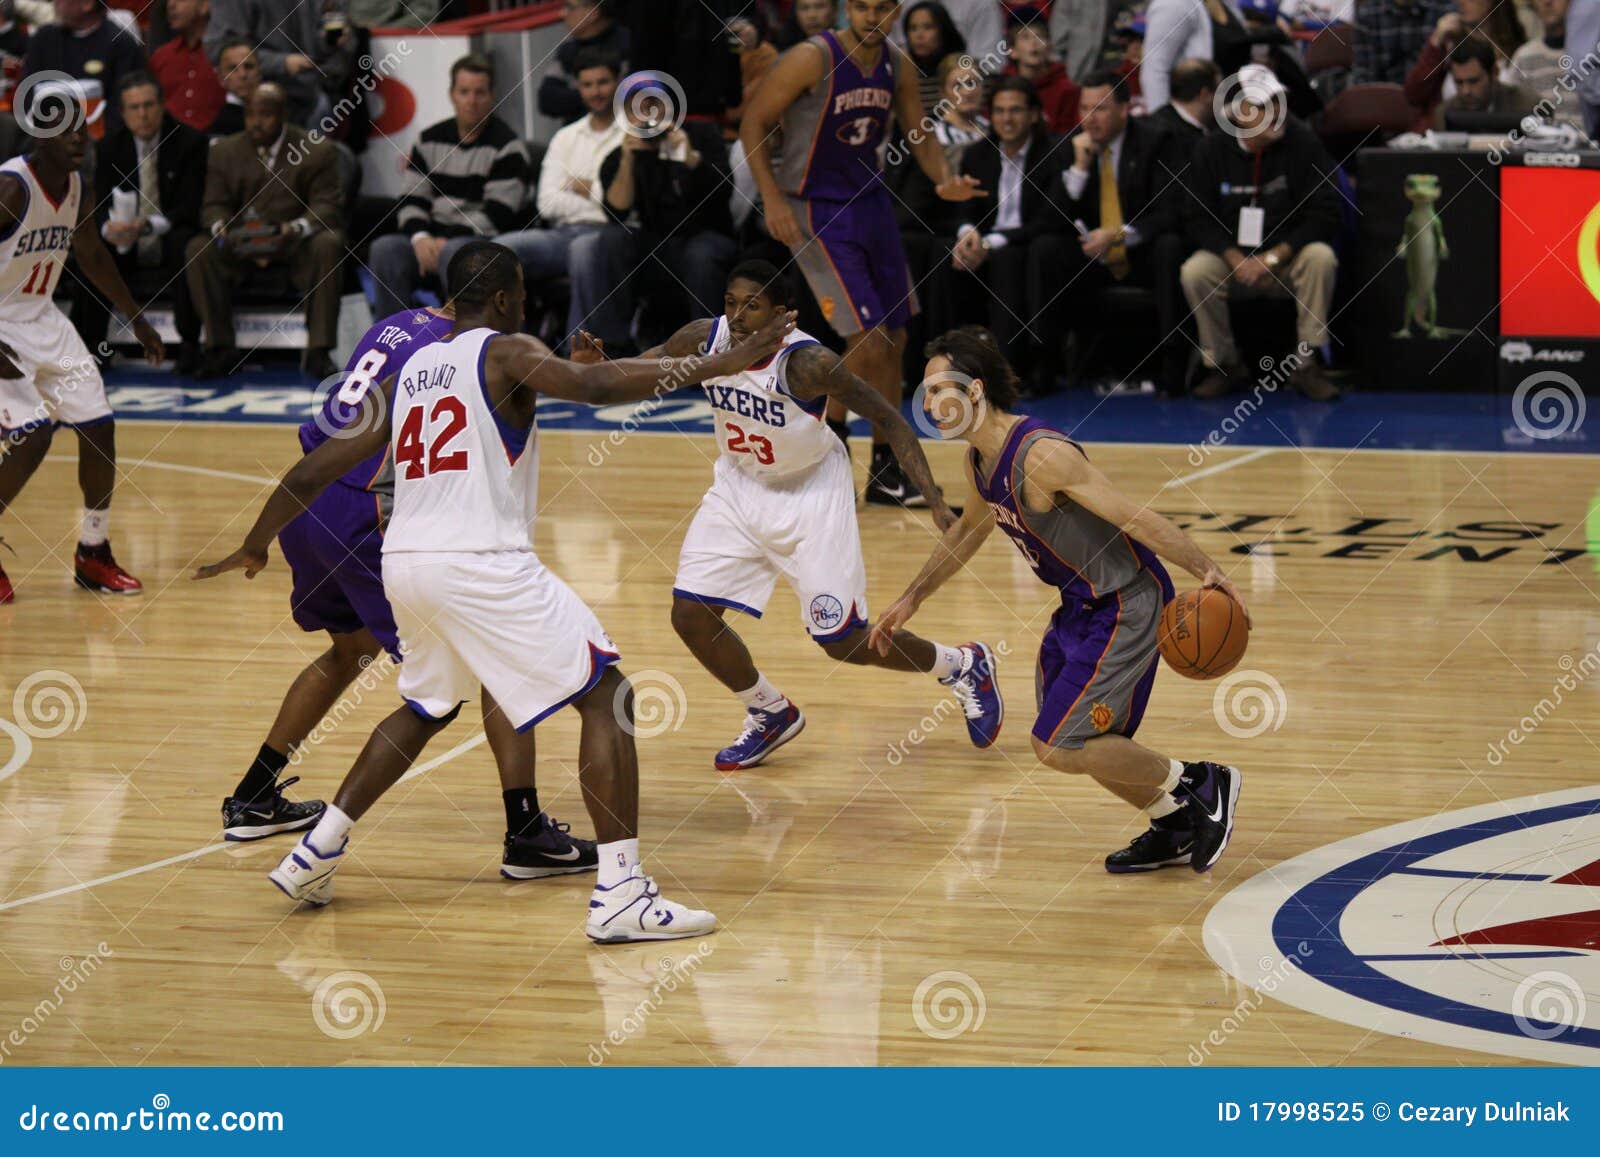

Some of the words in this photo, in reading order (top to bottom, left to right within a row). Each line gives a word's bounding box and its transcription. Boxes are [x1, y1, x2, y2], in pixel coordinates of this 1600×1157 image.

[1523, 152, 1580, 167] GEICO
[13, 226, 74, 258] SIXER
[22, 261, 54, 295] 11
[338, 349, 388, 405] 8
[704, 384, 786, 428] IXERS
[395, 394, 469, 481] 42
[724, 422, 776, 465] 23
